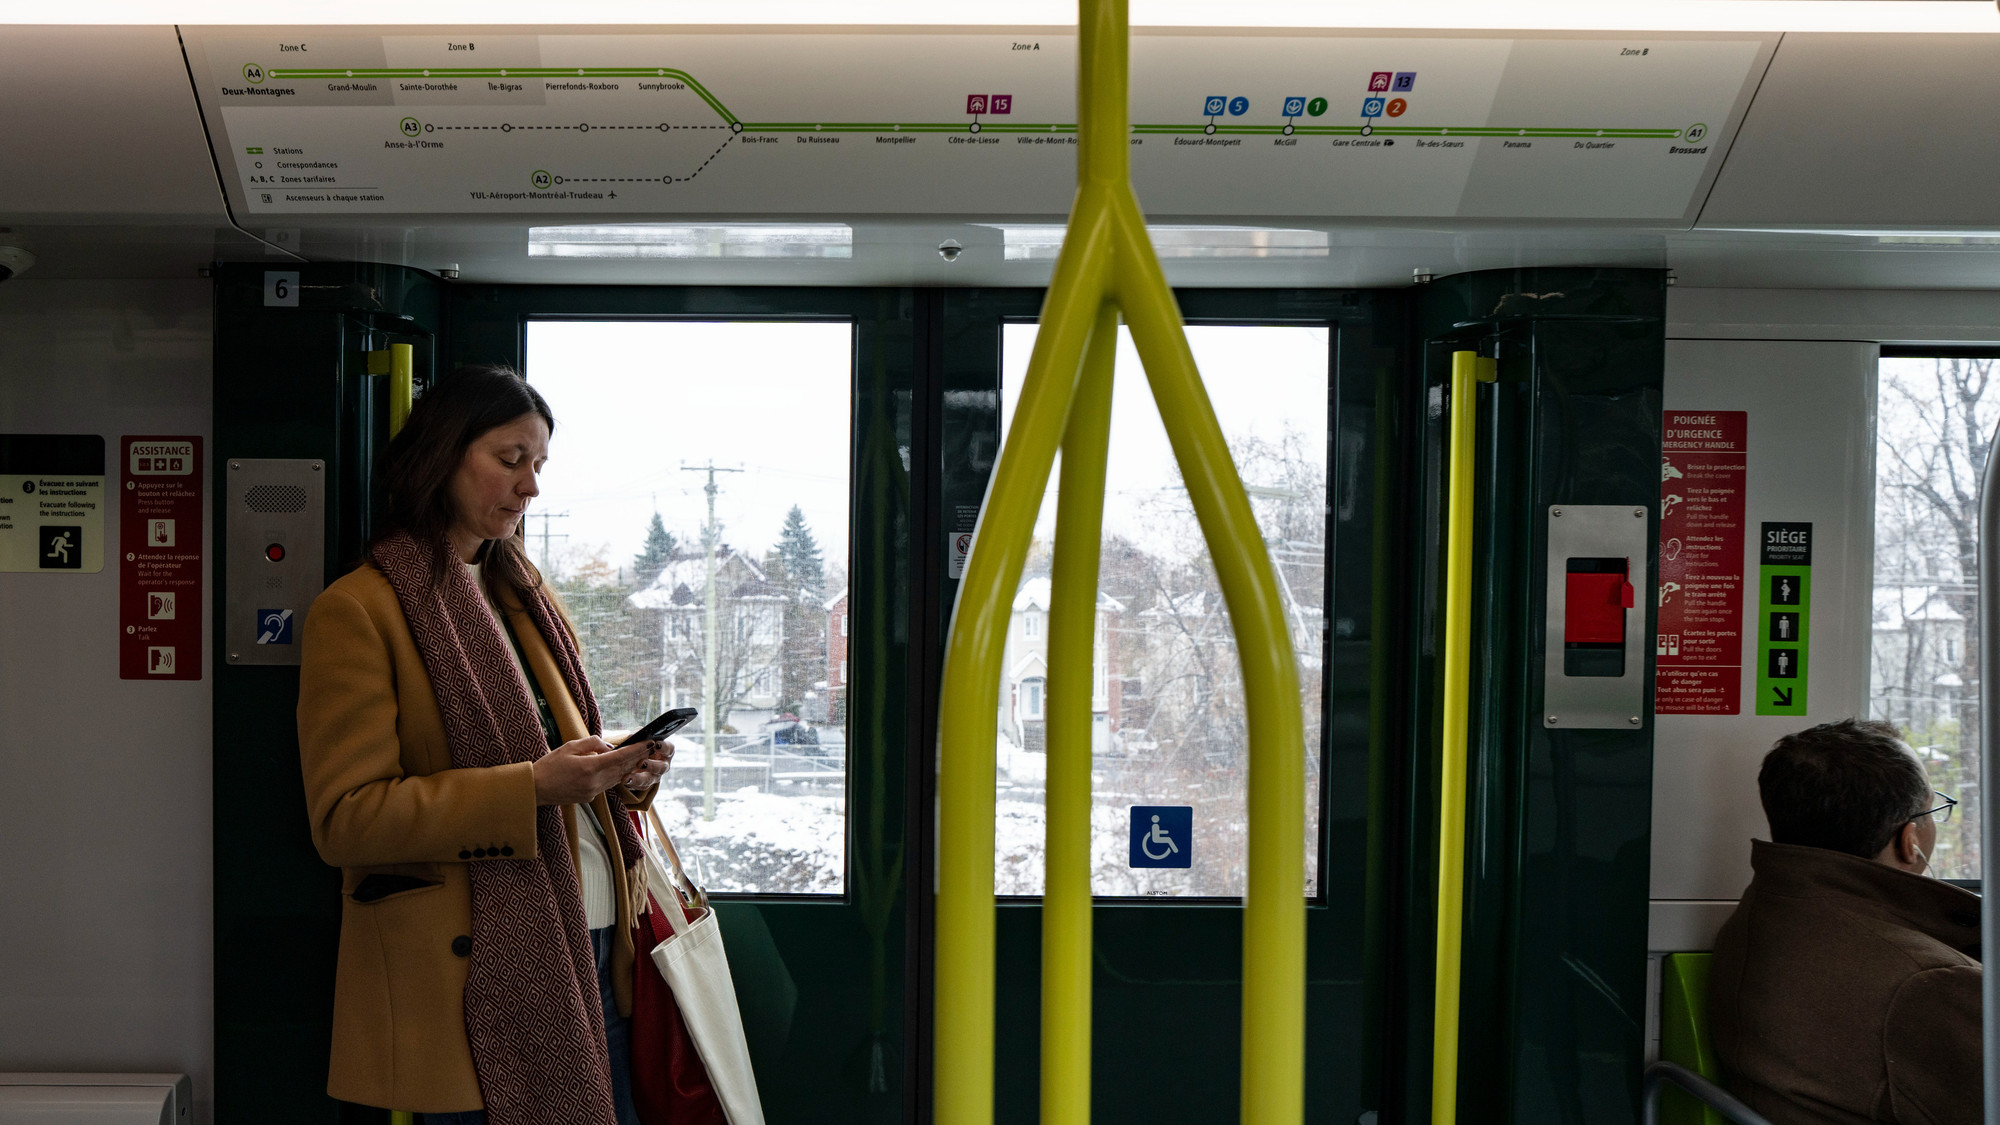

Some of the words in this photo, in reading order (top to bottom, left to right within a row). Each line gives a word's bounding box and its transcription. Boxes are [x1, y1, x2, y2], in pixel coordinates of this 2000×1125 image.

[280, 44, 299, 52] Zone
[448, 43, 467, 51] Zone
[469, 43, 475, 51] B
[1011, 43, 1031, 51] Zone
[1620, 48, 1641, 56] Zone
[1642, 48, 1649, 56] B
[247, 69, 261, 78] A4
[400, 83, 458, 91] Sainte-Dorothée
[488, 82, 523, 92] Île-Bigras
[545, 83, 619, 91] Pierrefonds-Roxboro
[1398, 77, 1411, 88] 13
[222, 87, 295, 97] Deux-Montagnes
[638, 83, 685, 92] Sunnybrooke
[994, 99, 1008, 110] 15
[1234, 101, 1243, 111] 5
[1314, 102, 1321, 112] 1
[1392, 102, 1401, 113] 2
[404, 123, 418, 131] A3
[1689, 129, 1702, 138] A1
[742, 136, 779, 144] Bois-Franc
[797, 136, 807, 144] Du
[808, 136, 840, 144] Ruisseau
[876, 136, 917, 145] Montpellier
[948, 135, 1000, 144] Côte-de-Liesse
[1017, 137, 1079, 146] Ville-de-Mont-Ro
[1174, 137, 1242, 147] Édouard-Montpetit
[1274, 138, 1297, 146] McGill
[1332, 139, 1349, 147] Gare
[1351, 139, 1381, 147] Centrale
[1416, 139, 1464, 148] Île-des-Sœurs
[384, 140, 444, 149] Anse-à-l'Orme
[1585, 142, 1615, 150] Quartier
[1669, 146, 1707, 154] Brossard
[277, 161, 338, 170] Correspondances
[250, 176, 258, 184] A,
[260, 176, 269, 184] B,
[304, 175, 336, 183] tarifaires
[535, 175, 548, 184] A2
[286, 194, 325, 202] Ascenseurs
[333, 194, 357, 203] chaque
[470, 191, 603, 201] YUL-Aéroport-Montréal-Trudeau
[275, 279, 287, 299] 6
[1673, 414, 1716, 425] POIGNÉE
[1666, 429, 1722, 438] D'URGENCE
[1705, 441, 1735, 449] HANDLE
[133, 447, 191, 455] ASSISTANCE
[1767, 528, 1807, 543] SIÈGE
